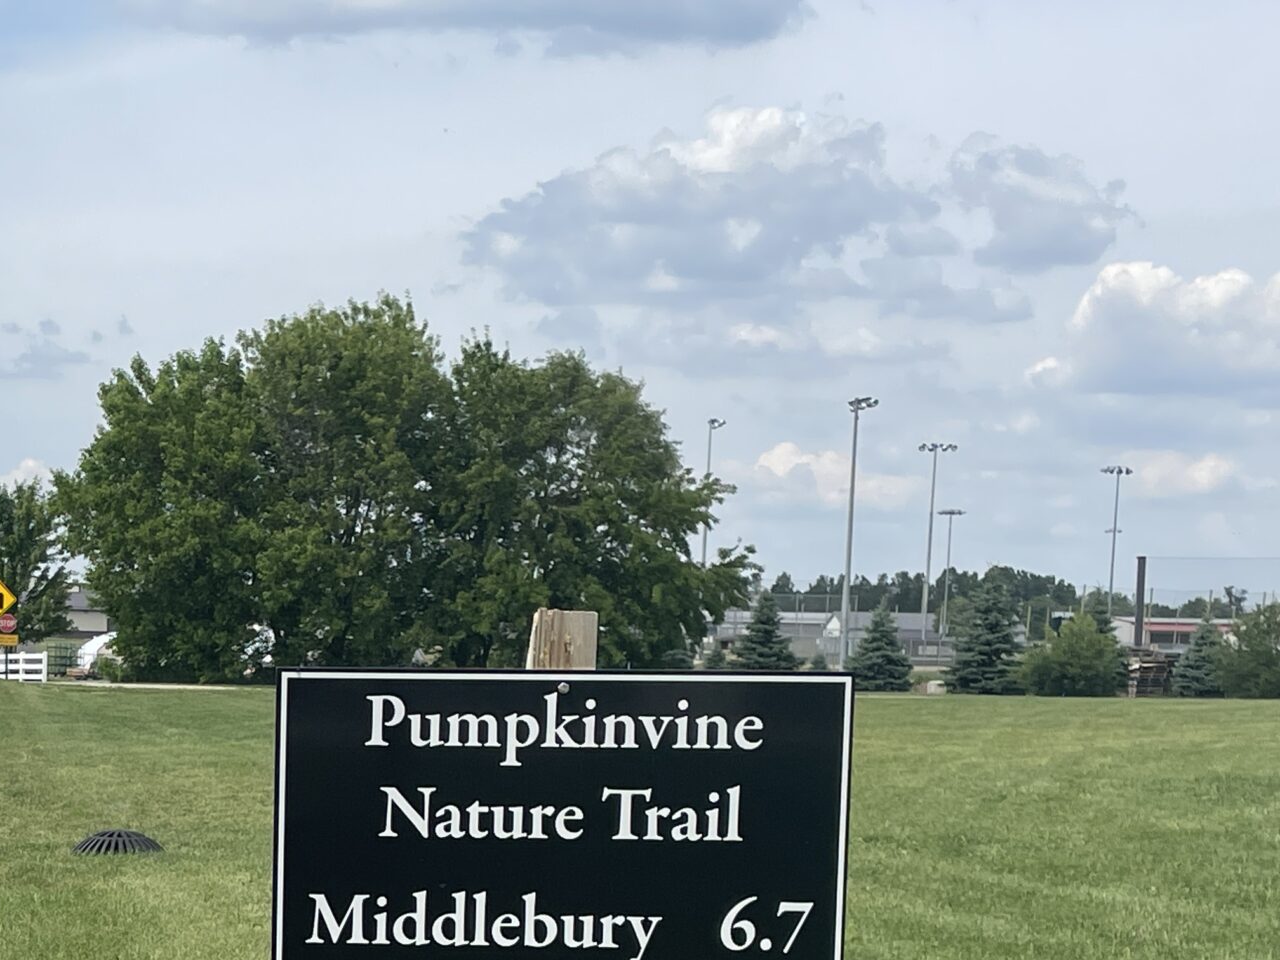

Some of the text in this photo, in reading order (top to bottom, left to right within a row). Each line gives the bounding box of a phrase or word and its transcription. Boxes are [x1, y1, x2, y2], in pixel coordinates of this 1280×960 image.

[0, 619, 17, 628] STOP
[364, 692, 764, 767] Pumpkinvine
[378, 784, 744, 842] Nature Trail
[720, 896, 814, 954] 6.7
